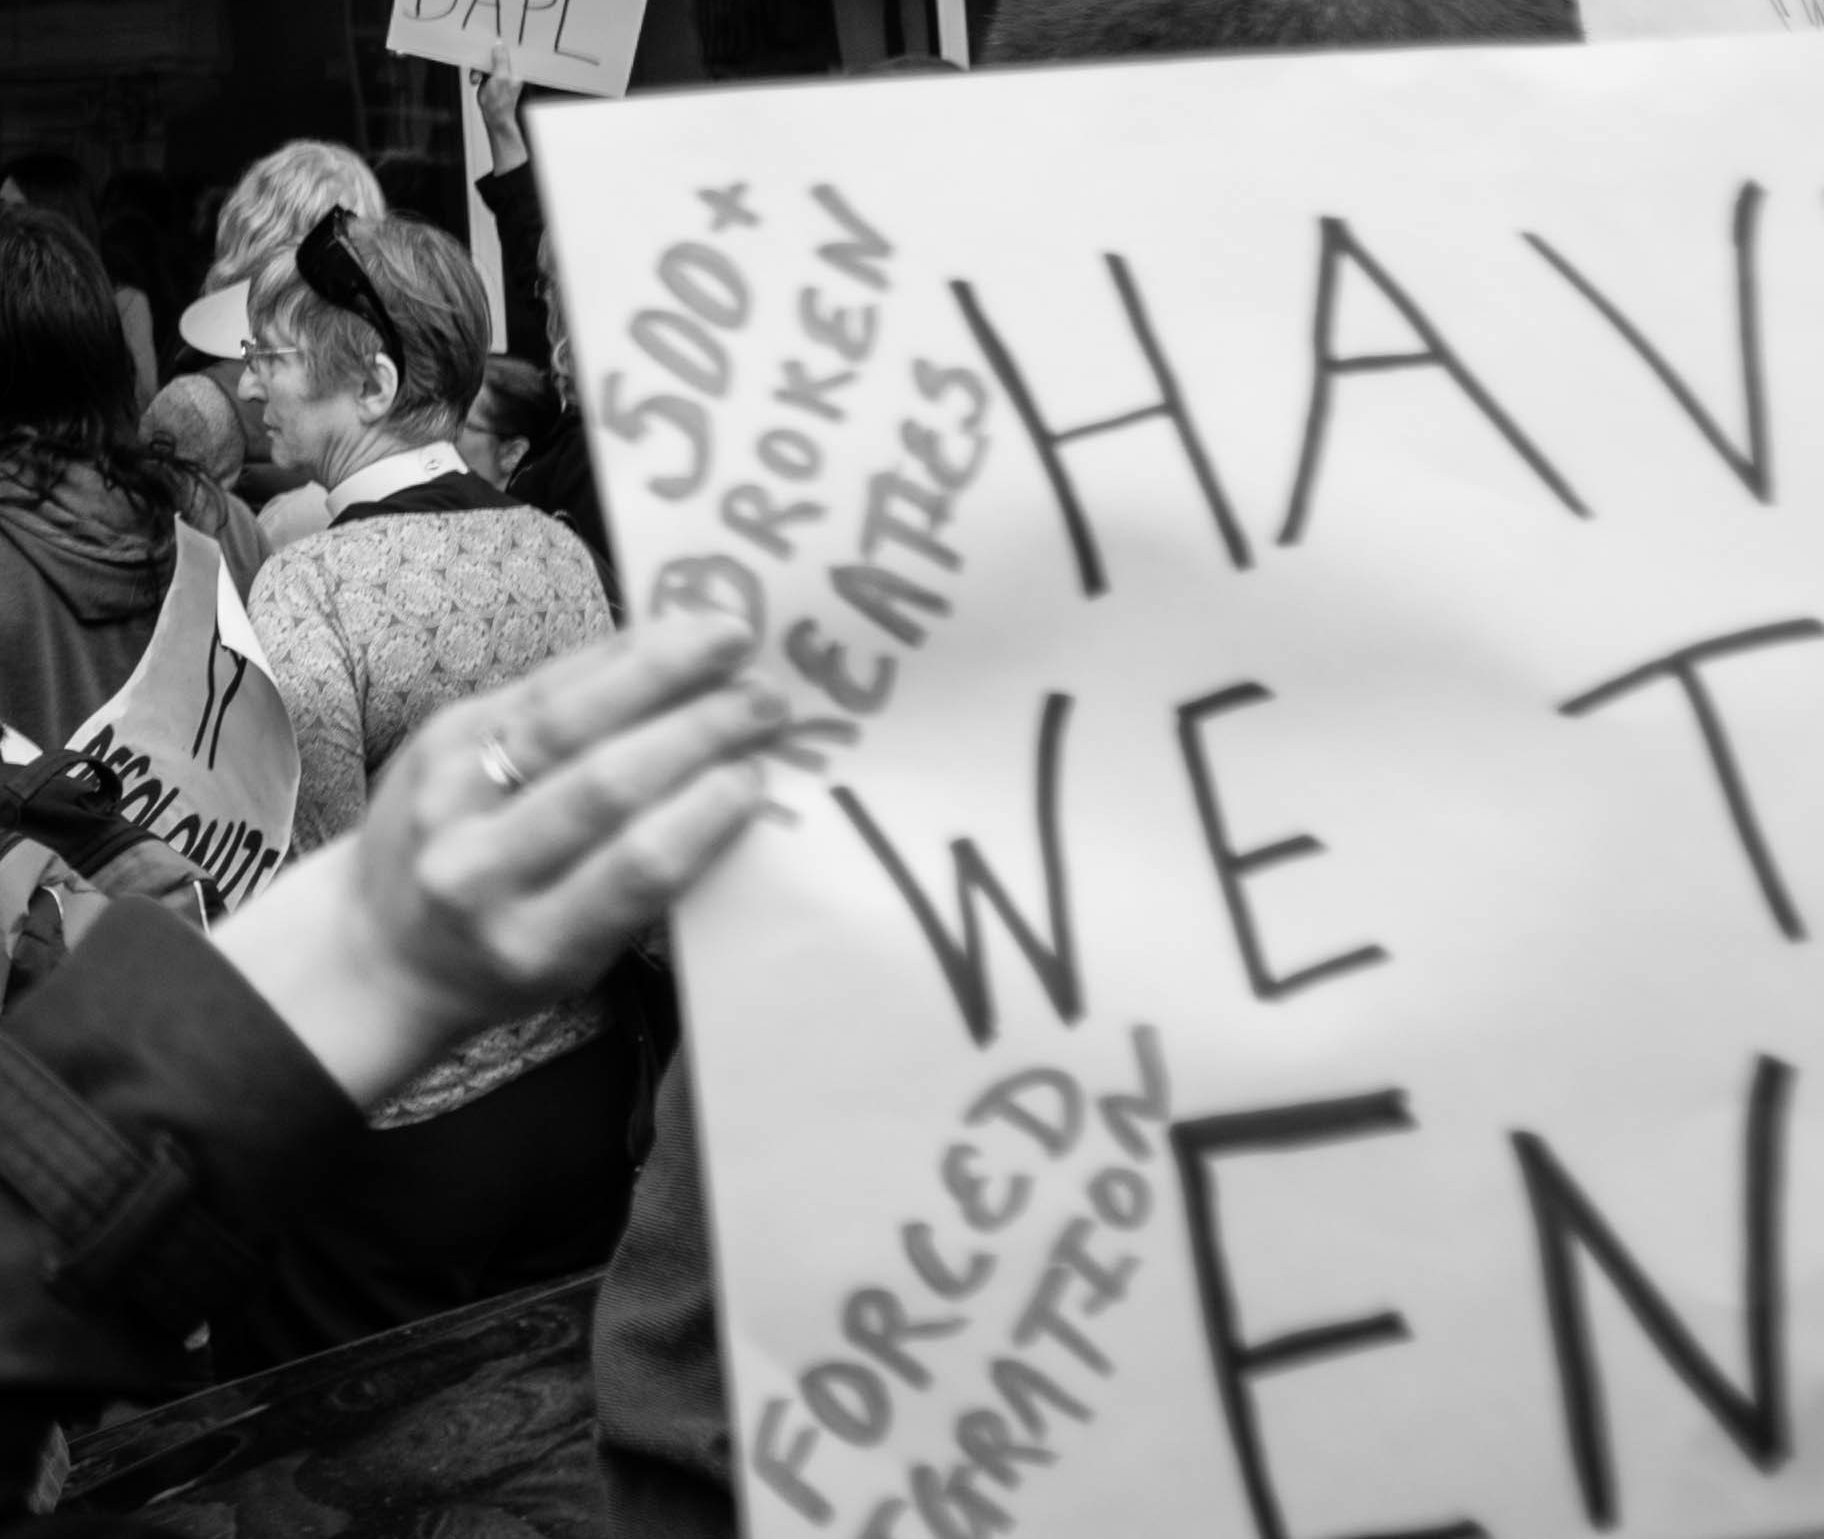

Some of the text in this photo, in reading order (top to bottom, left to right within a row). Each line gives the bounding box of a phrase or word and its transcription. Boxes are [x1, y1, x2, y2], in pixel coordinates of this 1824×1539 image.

[599, 178, 761, 502] 500+
[946, 176, 1824, 599] HAV
[829, 681, 1393, 1049] WE
[752, 1065, 1087, 1529] FORCED
